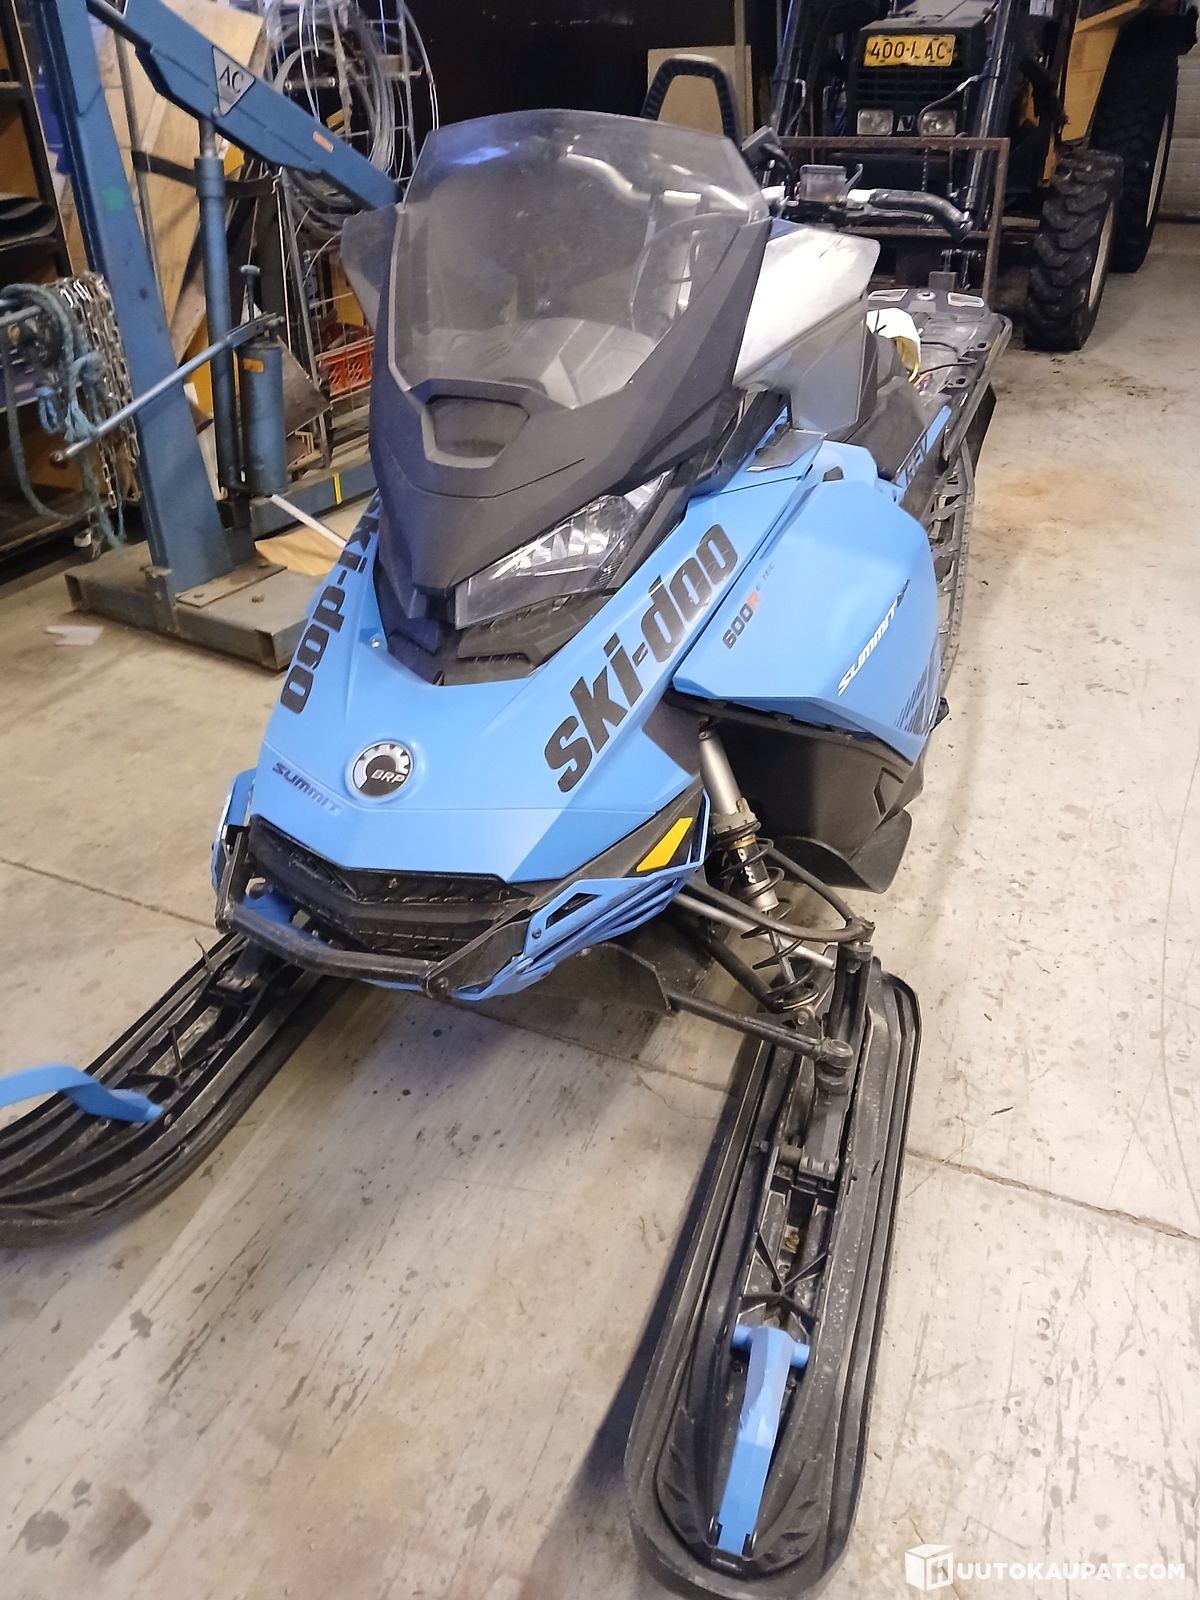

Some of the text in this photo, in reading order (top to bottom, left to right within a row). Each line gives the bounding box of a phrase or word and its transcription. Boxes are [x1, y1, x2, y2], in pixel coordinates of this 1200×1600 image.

[219, 64, 244, 93] AC
[544, 524, 738, 793] ski-doo
[272, 762, 343, 816] SUMMIT
